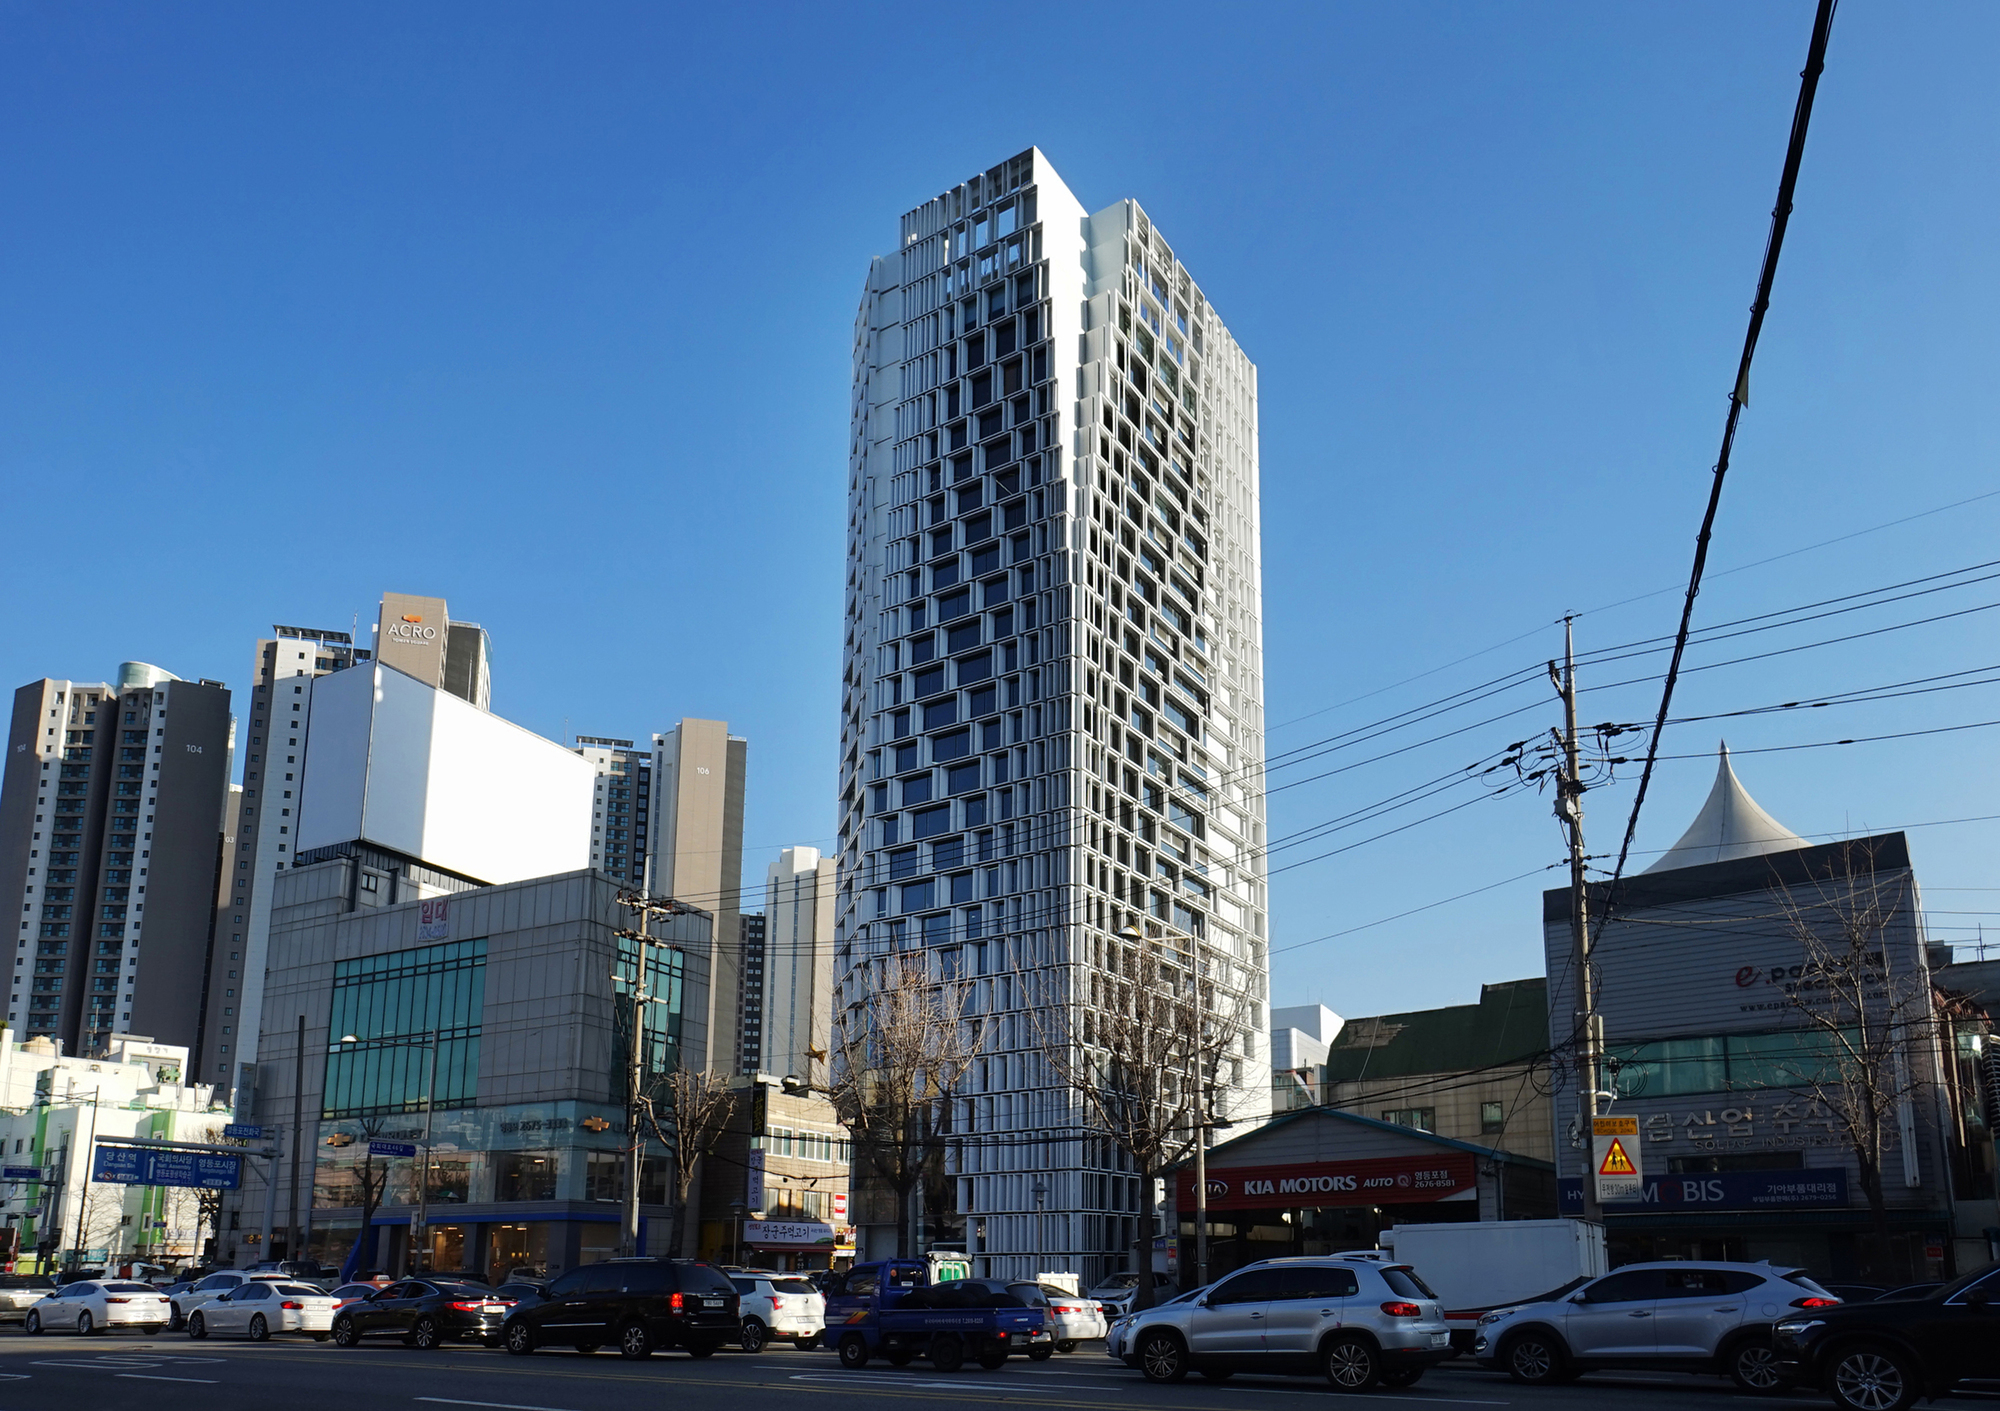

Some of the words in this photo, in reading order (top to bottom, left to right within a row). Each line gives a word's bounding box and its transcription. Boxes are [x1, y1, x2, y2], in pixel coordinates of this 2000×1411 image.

[387, 623, 436, 639] ACRO
[186, 744, 203, 754] 104
[696, 767, 710, 775] 106
[421, 898, 449, 924] 임대
[1593, 1120, 1636, 1128] 어린이보호구역
[1695, 1138, 1752, 1151] SOLTAP
[1762, 1135, 1833, 1149] INDUSTRY
[157, 1153, 193, 1165] 국회의사당
[198, 1158, 237, 1170] 영등포시장
[1414, 1170, 1448, 1181] 영등포점
[1244, 1179, 1275, 1196] KIA
[1279, 1175, 1357, 1194] MOTORS
[1363, 1177, 1394, 1188] AUTO
[1414, 1179, 1456, 1189] 2676-8581
[1767, 1182, 1837, 1194] 기아부품대리점
[1642, 1179, 1725, 1204] MOBIS
[762, 1223, 810, 1240] 장군주먹고기
